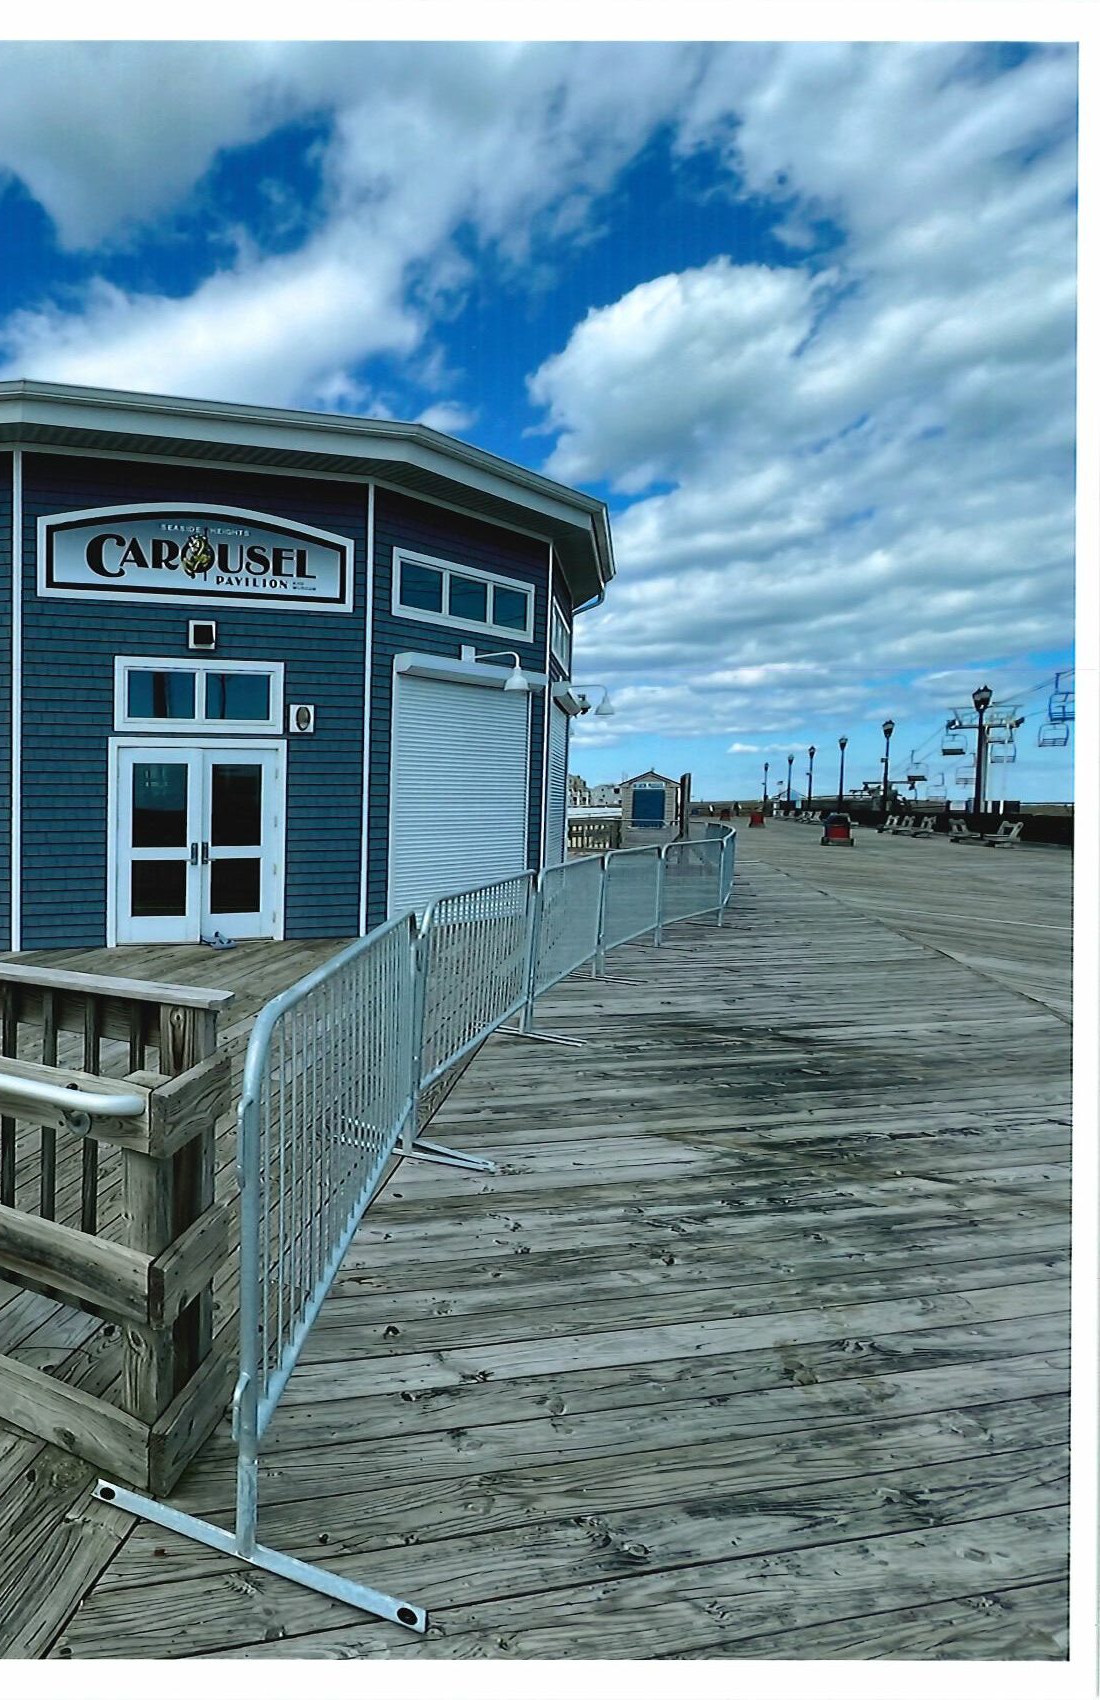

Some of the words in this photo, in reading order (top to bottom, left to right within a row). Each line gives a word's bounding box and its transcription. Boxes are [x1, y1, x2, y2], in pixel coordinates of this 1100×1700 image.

[161, 524, 201, 533] SEASIDE
[210, 528, 250, 537] HEIGHTS
[86, 533, 317, 580] CAROUSEL
[216, 575, 288, 590] PAVILION
